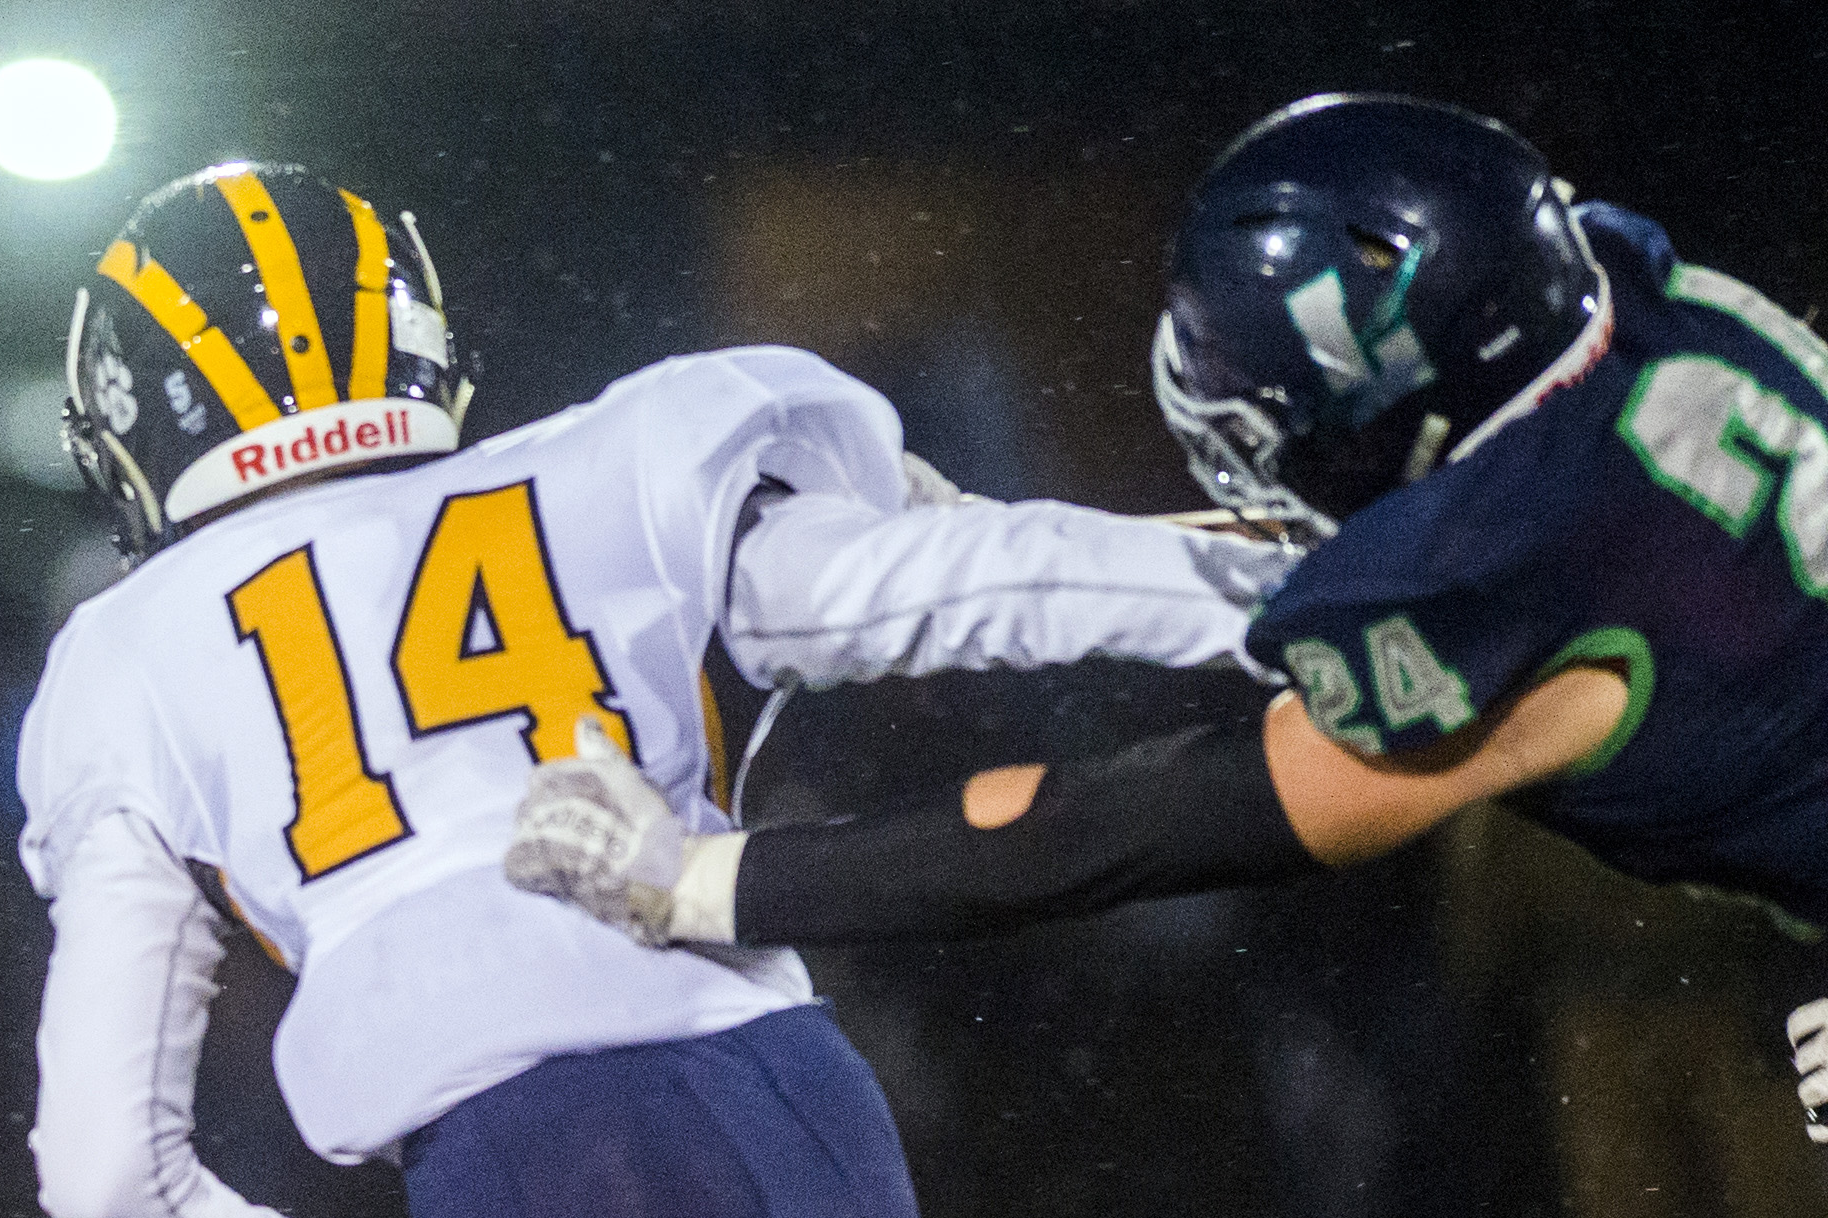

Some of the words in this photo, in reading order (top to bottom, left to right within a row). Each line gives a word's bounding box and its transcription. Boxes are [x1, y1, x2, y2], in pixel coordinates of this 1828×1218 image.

[231, 409, 410, 483] Riddell
[225, 477, 643, 886] 14
[1284, 614, 1477, 756] 24
